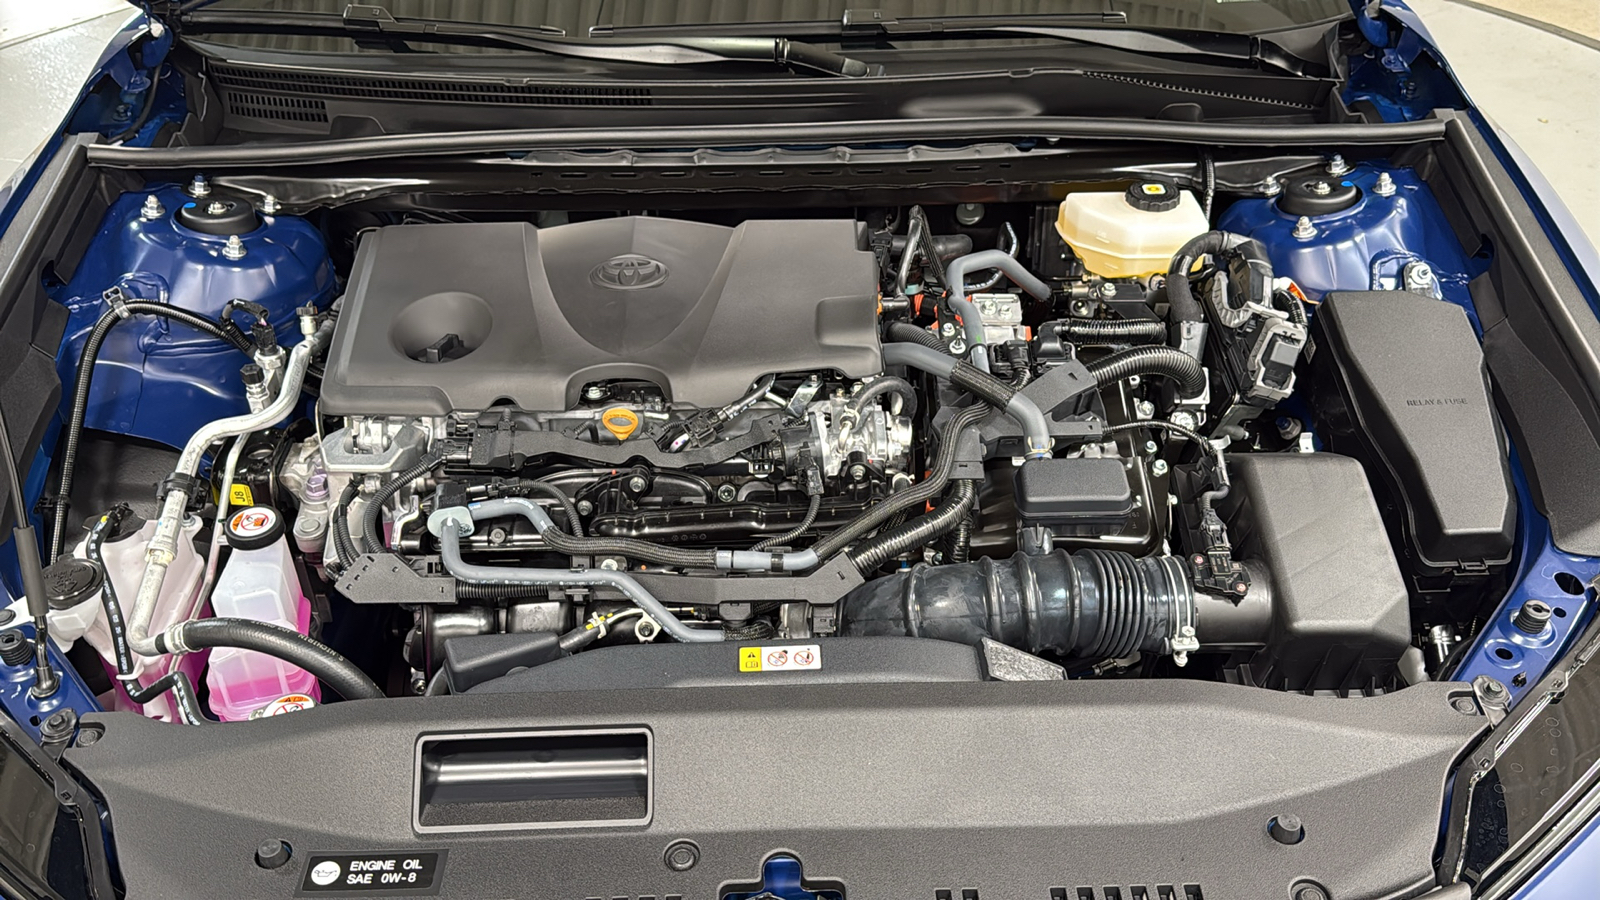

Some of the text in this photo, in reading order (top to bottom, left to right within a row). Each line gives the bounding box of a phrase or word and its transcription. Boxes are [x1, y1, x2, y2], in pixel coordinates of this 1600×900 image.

[234, 491, 245, 502] J8
[297, 633, 337, 656] NICHIRIN
[349, 859, 423, 871] ENGINE OIL
[346, 872, 417, 885] SAE 0W-8
